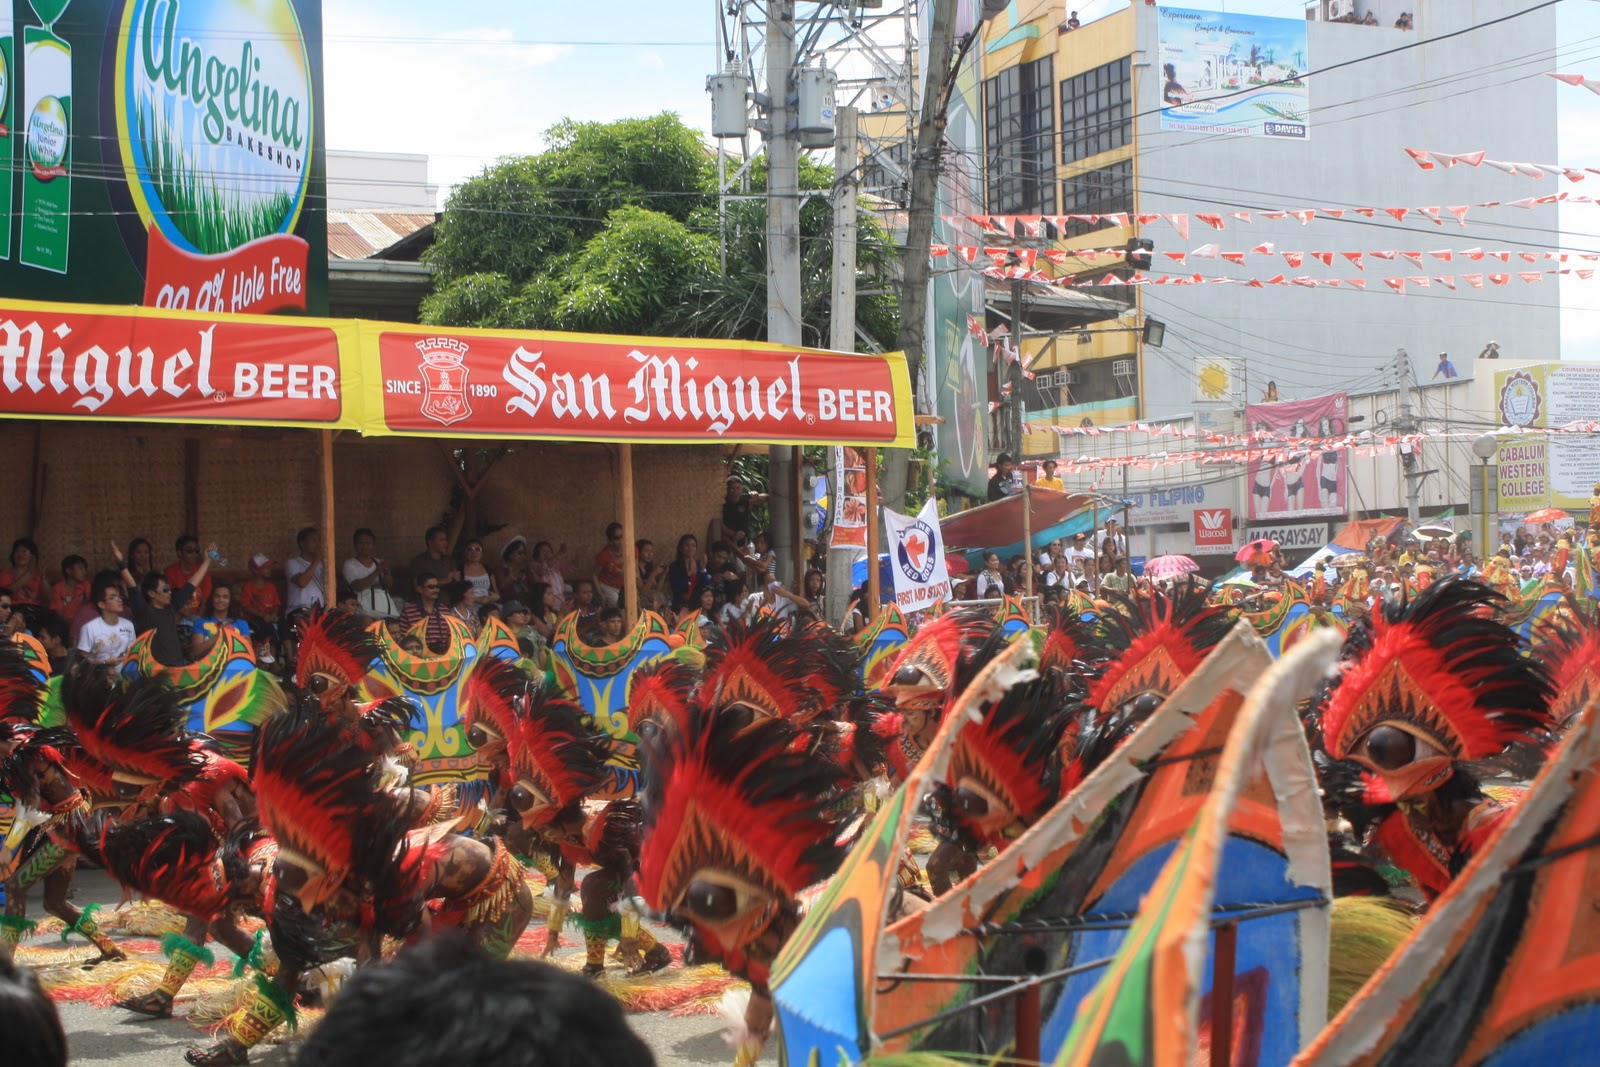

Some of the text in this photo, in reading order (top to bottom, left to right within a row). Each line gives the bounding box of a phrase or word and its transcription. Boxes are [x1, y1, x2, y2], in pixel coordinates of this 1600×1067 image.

[1194, 23, 1217, 34] Comfort
[142, 0, 304, 149] Angelina
[1274, 124, 1304, 135] DAVIES
[37, 133, 57, 147] Junior
[226, 125, 302, 173] BAKESHOP
[37, 144, 57, 158] White
[156, 256, 302, 314] 999% Hole Free
[232, 362, 338, 400] BEER
[386, 379, 498, 398] SINCE 1890
[502, 345, 894, 436] San Miguel BEER
[1499, 445, 1545, 463] CABALUM
[1500, 462, 1545, 480] WESTERN
[1149, 485, 1205, 507] FILIPINO
[1501, 479, 1545, 497] COLLEGE
[1198, 528, 1228, 538] Wacoal
[1249, 527, 1325, 547] MAGSAYSAY
[902, 563, 919, 580] RED
[897, 590, 913, 606] FIRST
[914, 587, 926, 602] AID
